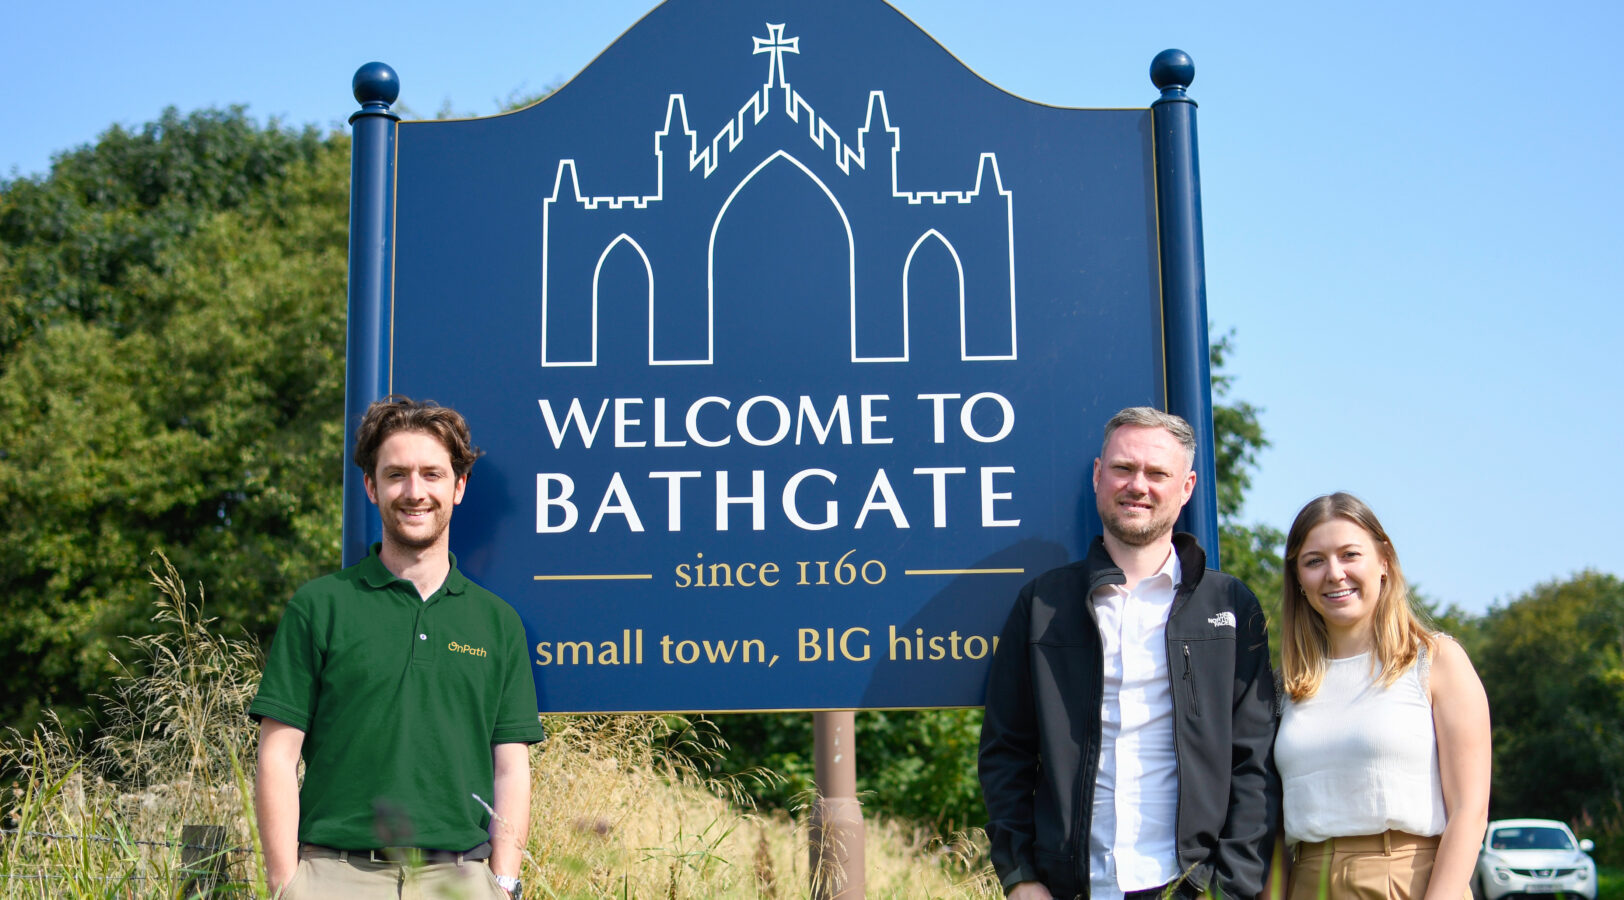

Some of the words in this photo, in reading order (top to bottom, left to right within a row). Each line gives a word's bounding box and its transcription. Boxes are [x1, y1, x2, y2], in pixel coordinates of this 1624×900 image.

[538, 394, 894, 450] WELCOME
[917, 391, 1015, 444] TO
[535, 465, 1021, 534] BATHGATE
[675, 552, 780, 588] since
[797, 548, 888, 586] 1160
[448, 641, 487, 658] OnPath
[536, 628, 644, 666] small
[660, 635, 780, 668] town,
[798, 626, 871, 662] BIG
